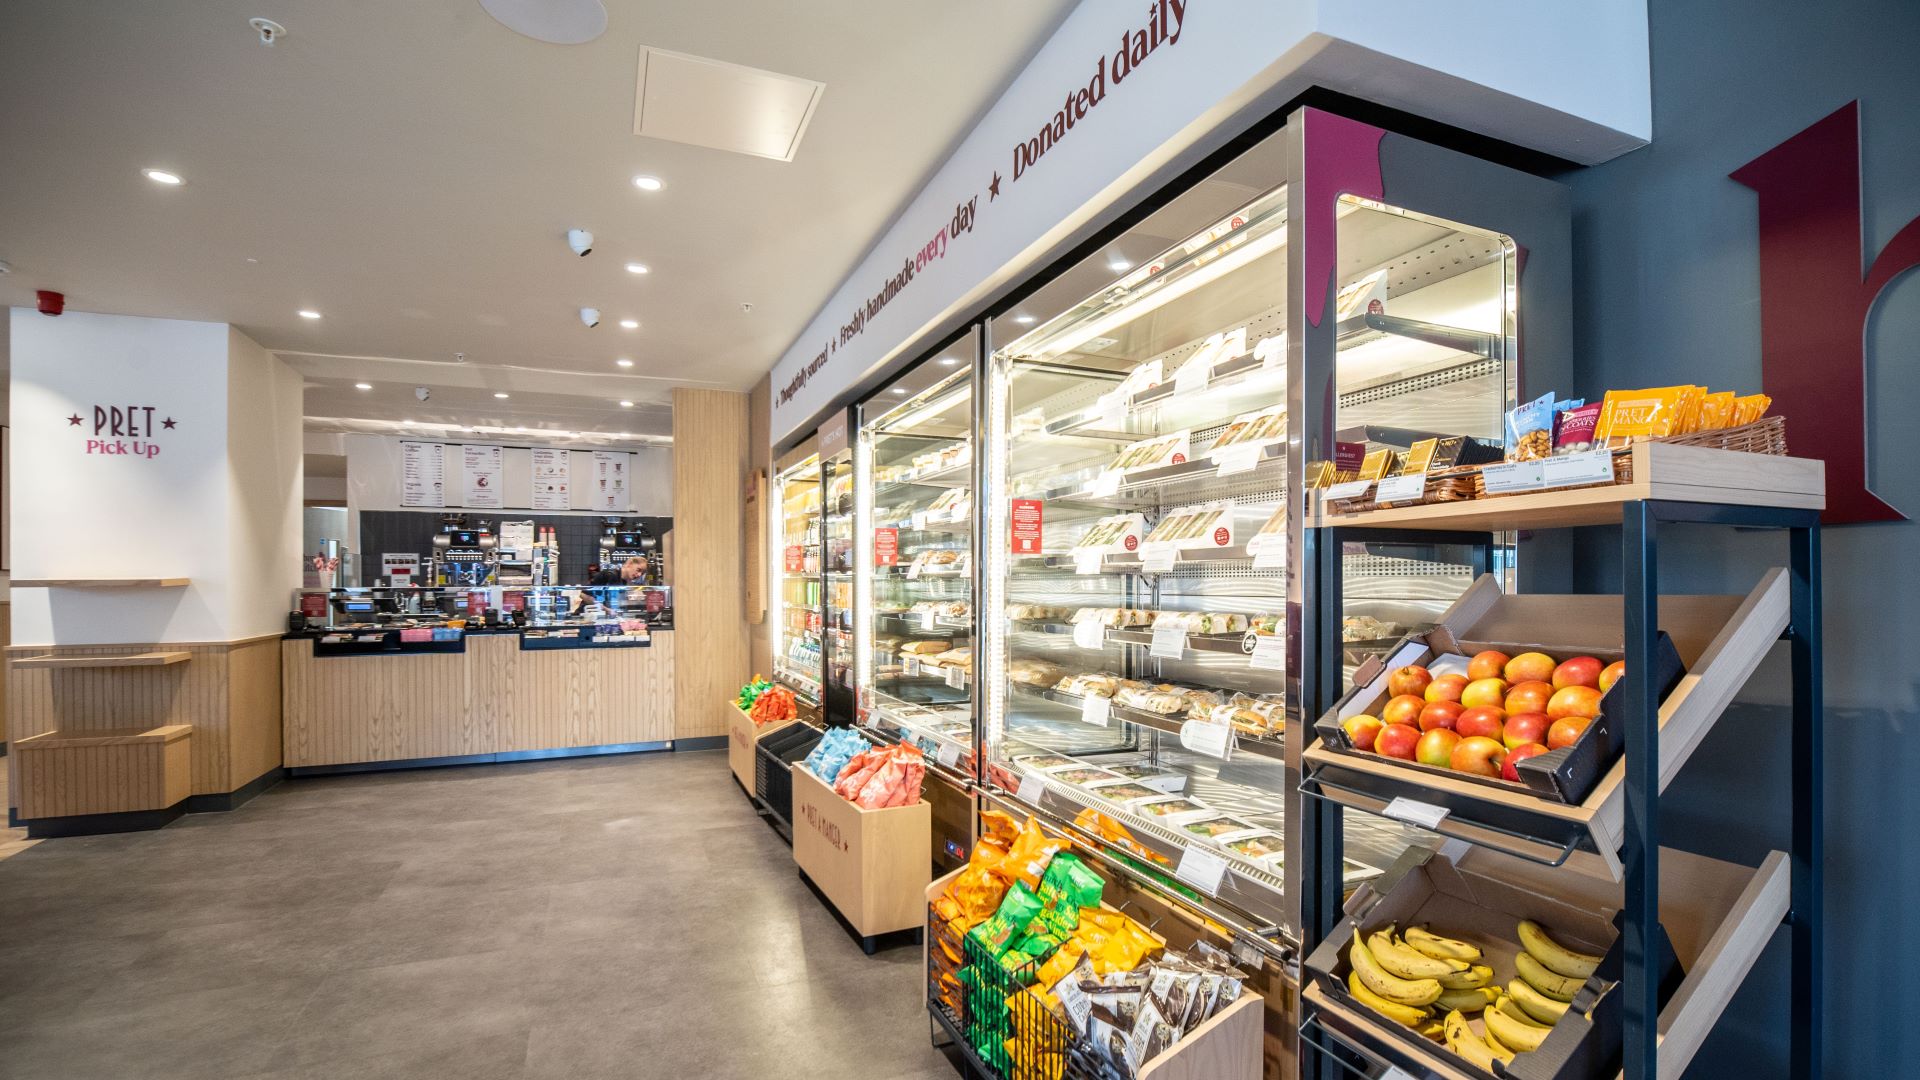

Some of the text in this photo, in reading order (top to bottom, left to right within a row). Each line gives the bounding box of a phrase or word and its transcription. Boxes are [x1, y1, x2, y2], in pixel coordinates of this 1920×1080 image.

[780, 0, 1188, 405] Thoughtfully sourced Freshly handmade every day Donated daily
[93, 404, 157, 438] PRET
[1615, 407, 1649, 418] PRET
[86, 439, 161, 459] Pick Up
